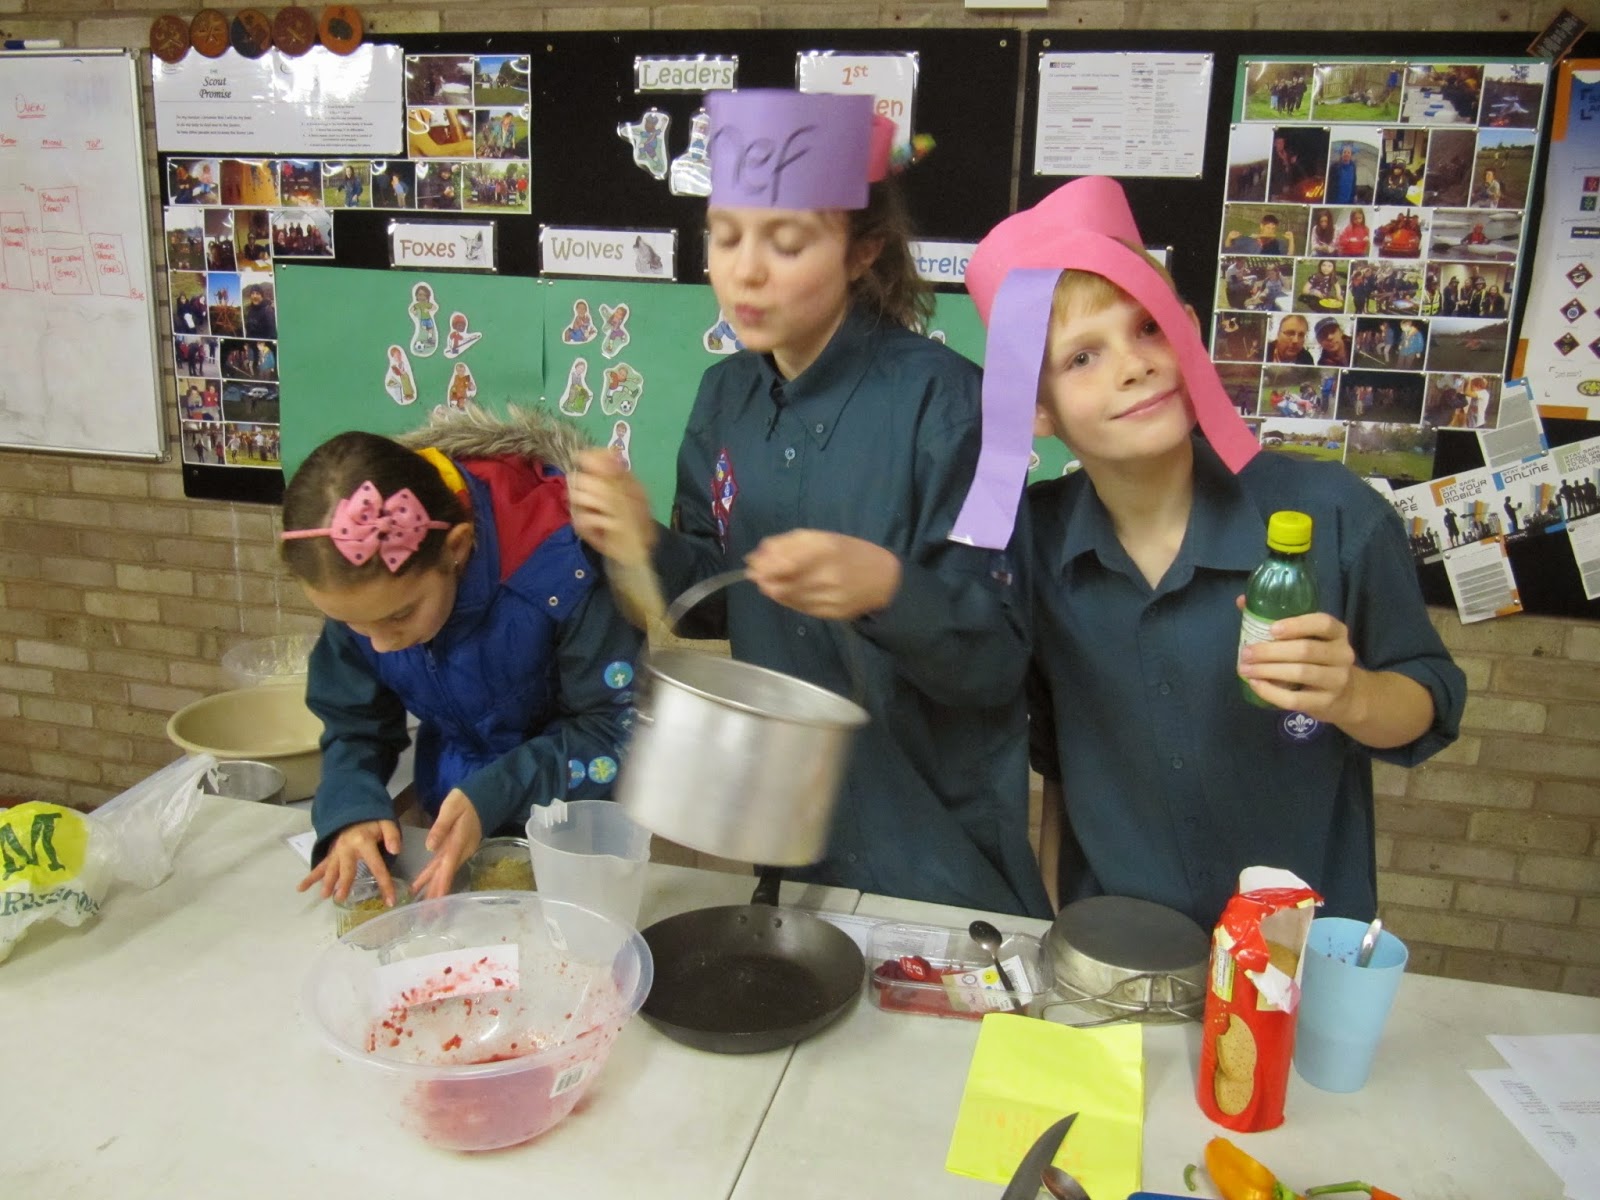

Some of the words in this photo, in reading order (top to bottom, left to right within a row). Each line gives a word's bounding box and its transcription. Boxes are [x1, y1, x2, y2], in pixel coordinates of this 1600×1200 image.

[203, 76, 227, 87] Scout
[641, 63, 733, 88] Leaders
[841, 65, 869, 86] 1st
[199, 88, 232, 99] Promise
[875, 98, 904, 118] en
[399, 238, 457, 260] Foxes
[550, 236, 625, 262] Wolves
[916, 254, 970, 277] trels
[1564, 450, 1582, 460] STAY
[1502, 467, 1520, 477] STAY
[1520, 461, 1539, 471] SAFE
[1504, 463, 1551, 485] ONLINE
[1441, 484, 1458, 493] STAY
[1460, 477, 1477, 487] SAFE
[1460, 480, 1488, 494] YOUR
[1444, 488, 1483, 504] MOBILE
